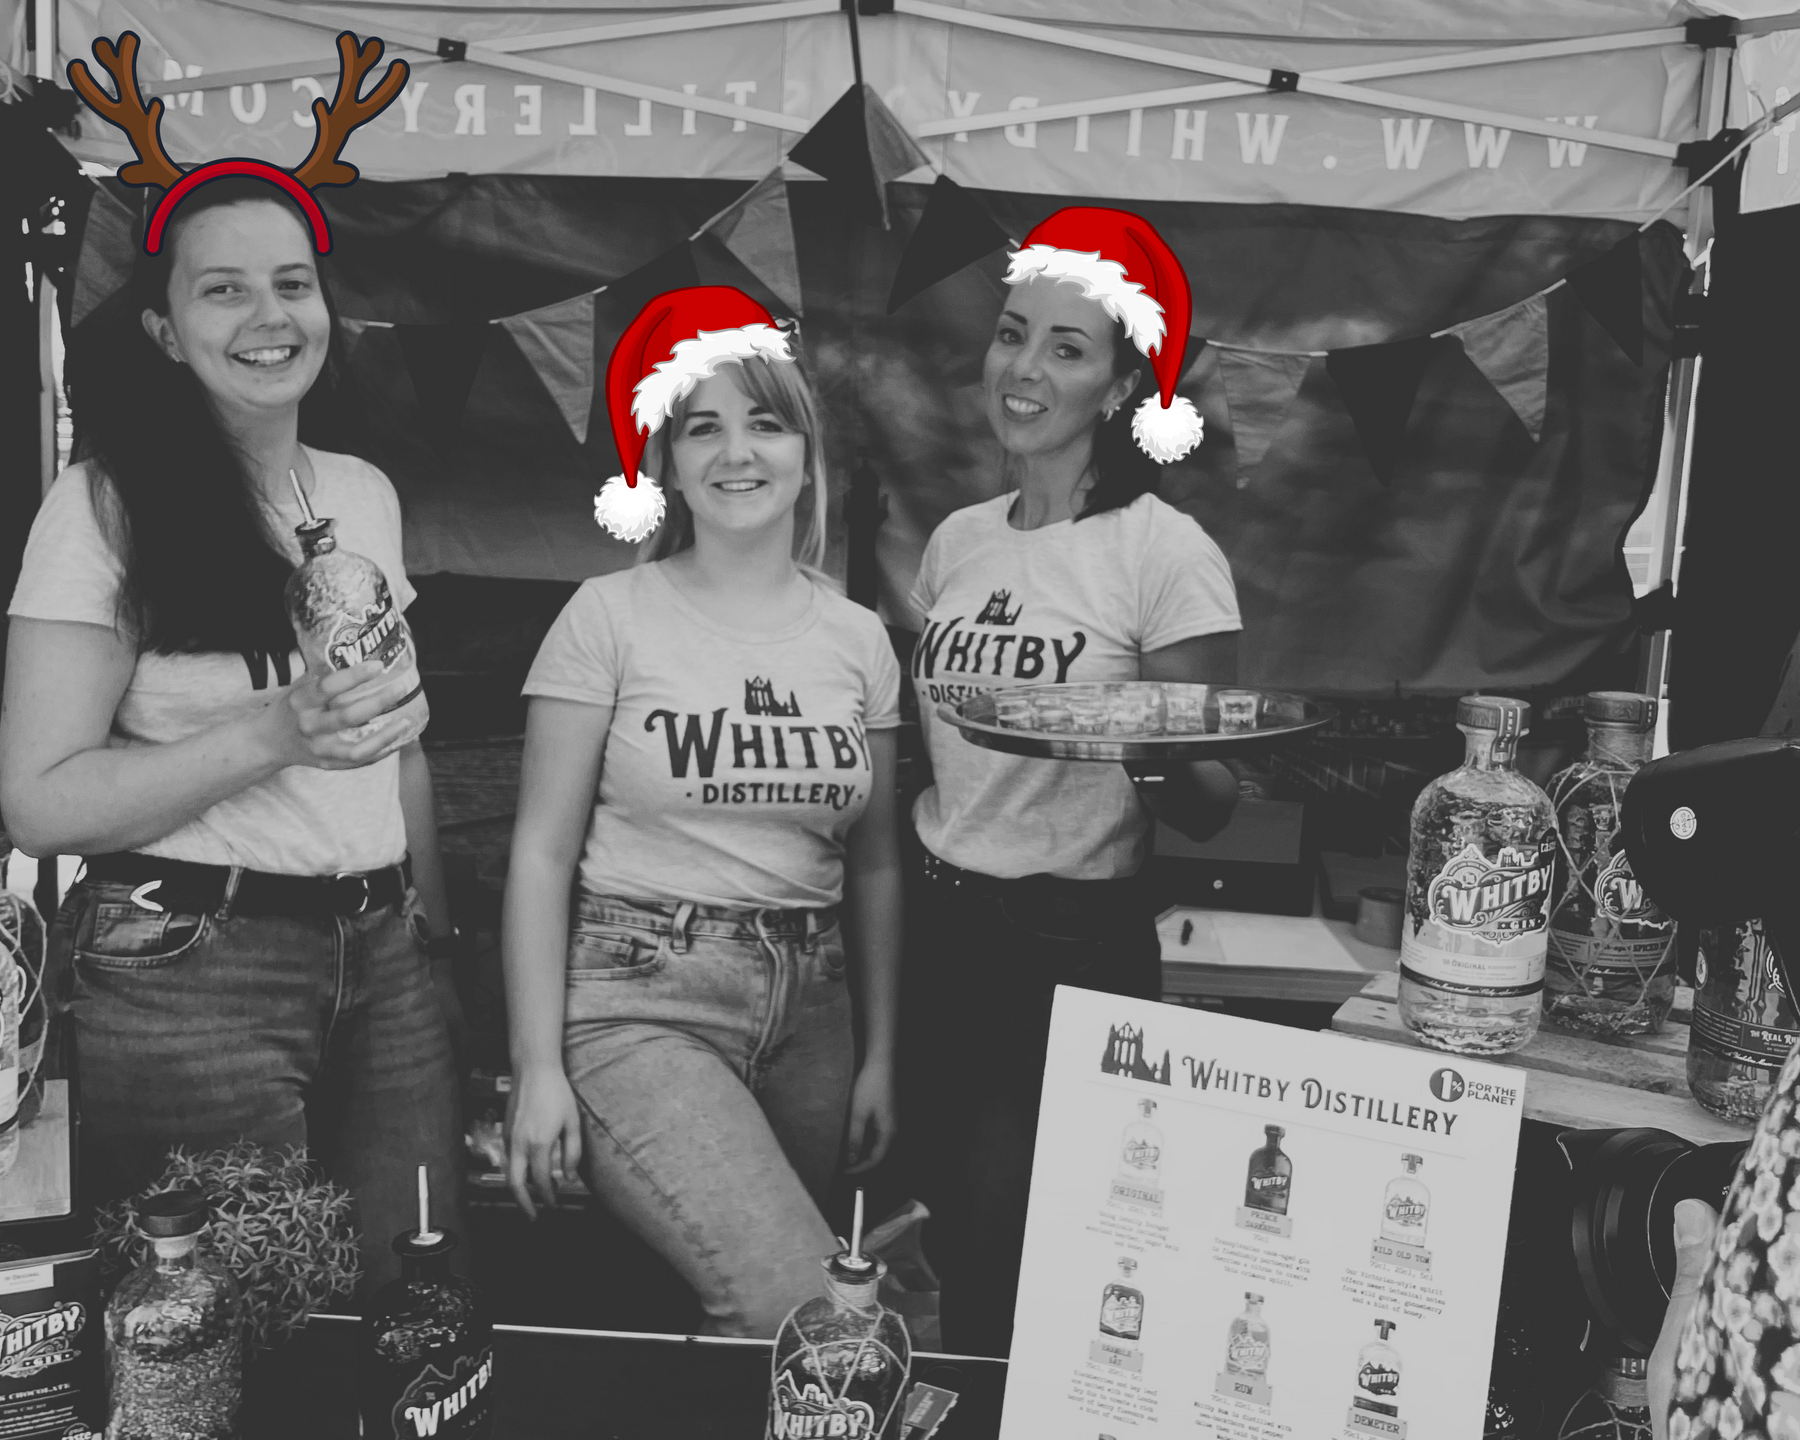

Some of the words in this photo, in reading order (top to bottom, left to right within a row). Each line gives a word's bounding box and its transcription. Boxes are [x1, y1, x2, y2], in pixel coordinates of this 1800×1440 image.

[914, 616, 1086, 684] WHITBY
[644, 707, 870, 778] WHITBY
[703, 782, 856, 811] DISTILLERY
[1442, 865, 1550, 921] WHITBY
[1510, 918, 1536, 929] GIN
[1452, 960, 1486, 971] ORIGINAL
[1761, 1030, 1782, 1042] REAL
[1182, 1055, 1291, 1102] WHITBY
[1301, 1077, 1458, 1135] DISTILLERY
[1467, 1090, 1516, 1106] PLANET
[1469, 1081, 1493, 1094] FOR
[1495, 1085, 1517, 1097] THE
[1113, 1185, 1160, 1203] ORIGINAL
[1374, 1245, 1393, 1256] WILD
[1396, 1250, 1411, 1260] OLD
[1415, 1254, 1430, 1264] TOM
[0, 1305, 80, 1356] HITBY
[33, 1354, 62, 1366] GIN
[1234, 1382, 1253, 1395] RUM
[1354, 1414, 1400, 1434] DEMETER
